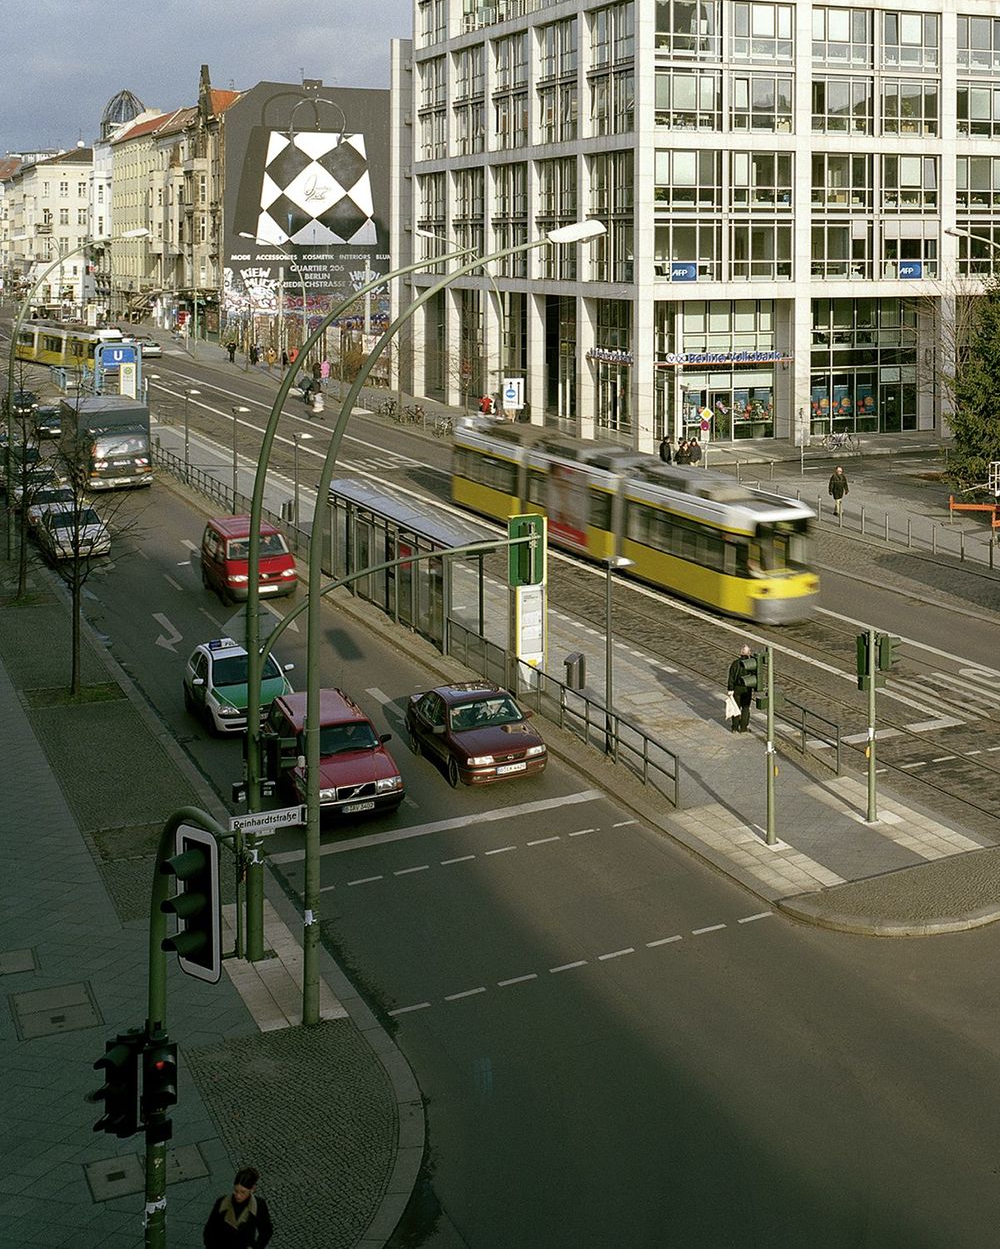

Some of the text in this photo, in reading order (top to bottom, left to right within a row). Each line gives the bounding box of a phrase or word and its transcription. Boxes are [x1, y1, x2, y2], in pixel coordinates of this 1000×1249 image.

[290, 264, 345, 272] QUARTIER 206
[672, 269, 688, 277] AFP
[113, 350, 123, 361] U
[688, 351, 782, 364] Berliner Volksbank
[233, 812, 297, 830] Reinhardtstraße
